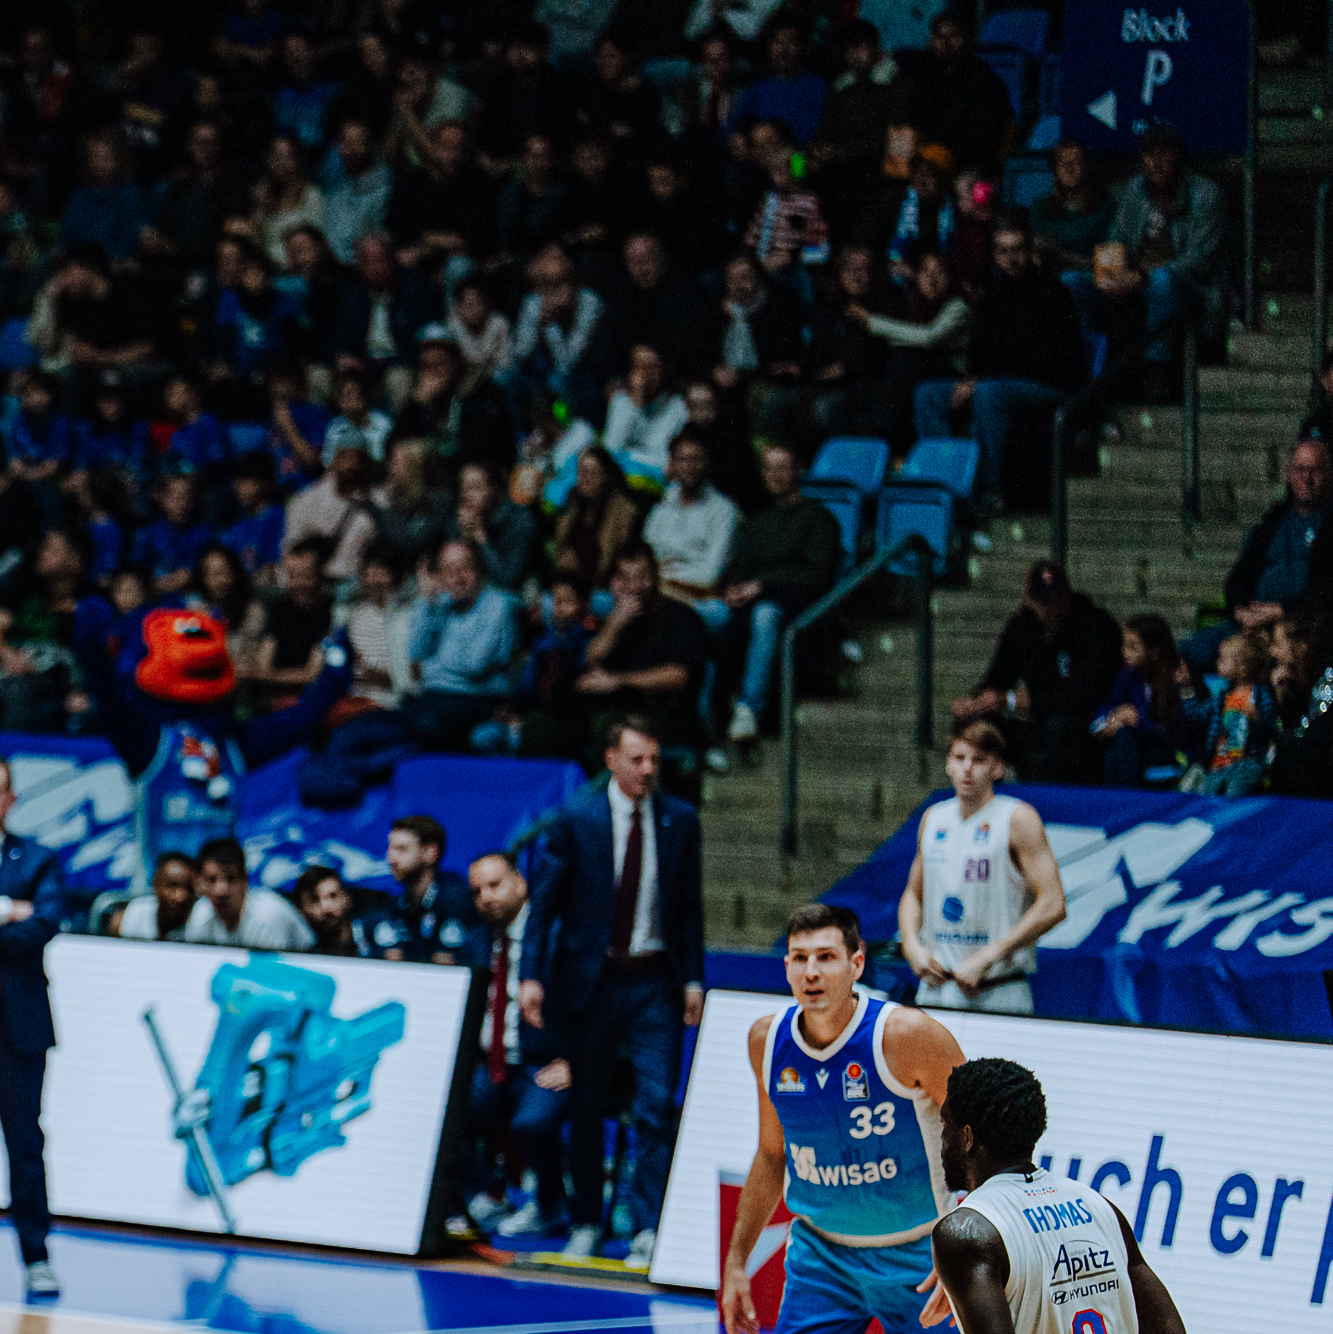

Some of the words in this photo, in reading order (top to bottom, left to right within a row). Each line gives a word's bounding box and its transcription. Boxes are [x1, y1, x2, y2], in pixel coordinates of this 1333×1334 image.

[1121, 7, 1190, 42] Block
[1141, 50, 1172, 105] P
[849, 1101, 895, 1139] 33
[1023, 1199, 1093, 1234] THOMAS
[1209, 1172, 1305, 1258] er
[1051, 1244, 1114, 1281] Apitz
[1069, 1279, 1119, 1301] HYUNDAI
